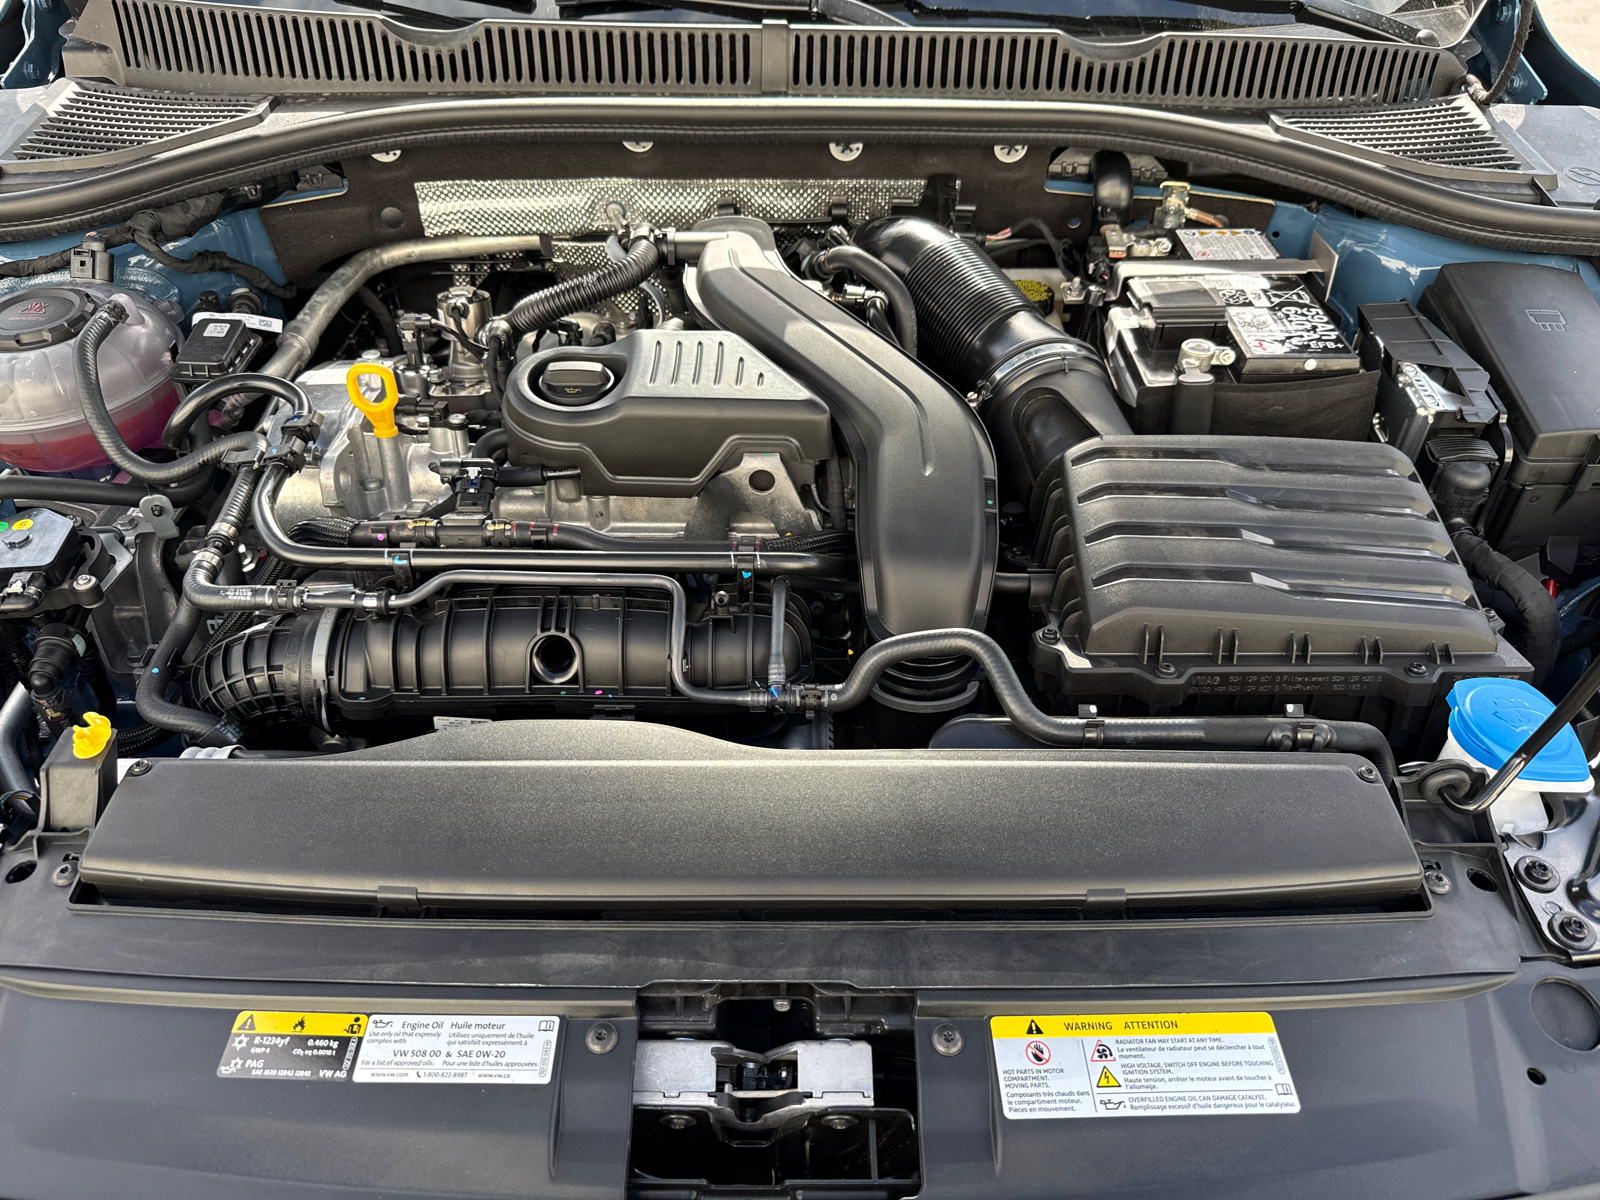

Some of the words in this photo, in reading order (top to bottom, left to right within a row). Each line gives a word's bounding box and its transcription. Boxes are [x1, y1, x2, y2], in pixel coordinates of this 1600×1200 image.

[1302, 307, 1338, 340] 59Ah
[402, 1021, 430, 1031] Engine
[431, 1021, 444, 1029] Oil
[1064, 1022, 1112, 1030] WARNING
[1124, 1020, 1178, 1030] ATTENTION
[253, 1036, 290, 1047] R-1234yf
[307, 1039, 329, 1047] 0.460
[329, 1039, 339, 1049] kg
[429, 1050, 441, 1058] 00
[457, 1050, 474, 1058] SAE
[475, 1050, 506, 1058] 0W-20
[245, 1060, 264, 1068] PAG
[333, 1070, 347, 1078] AG
